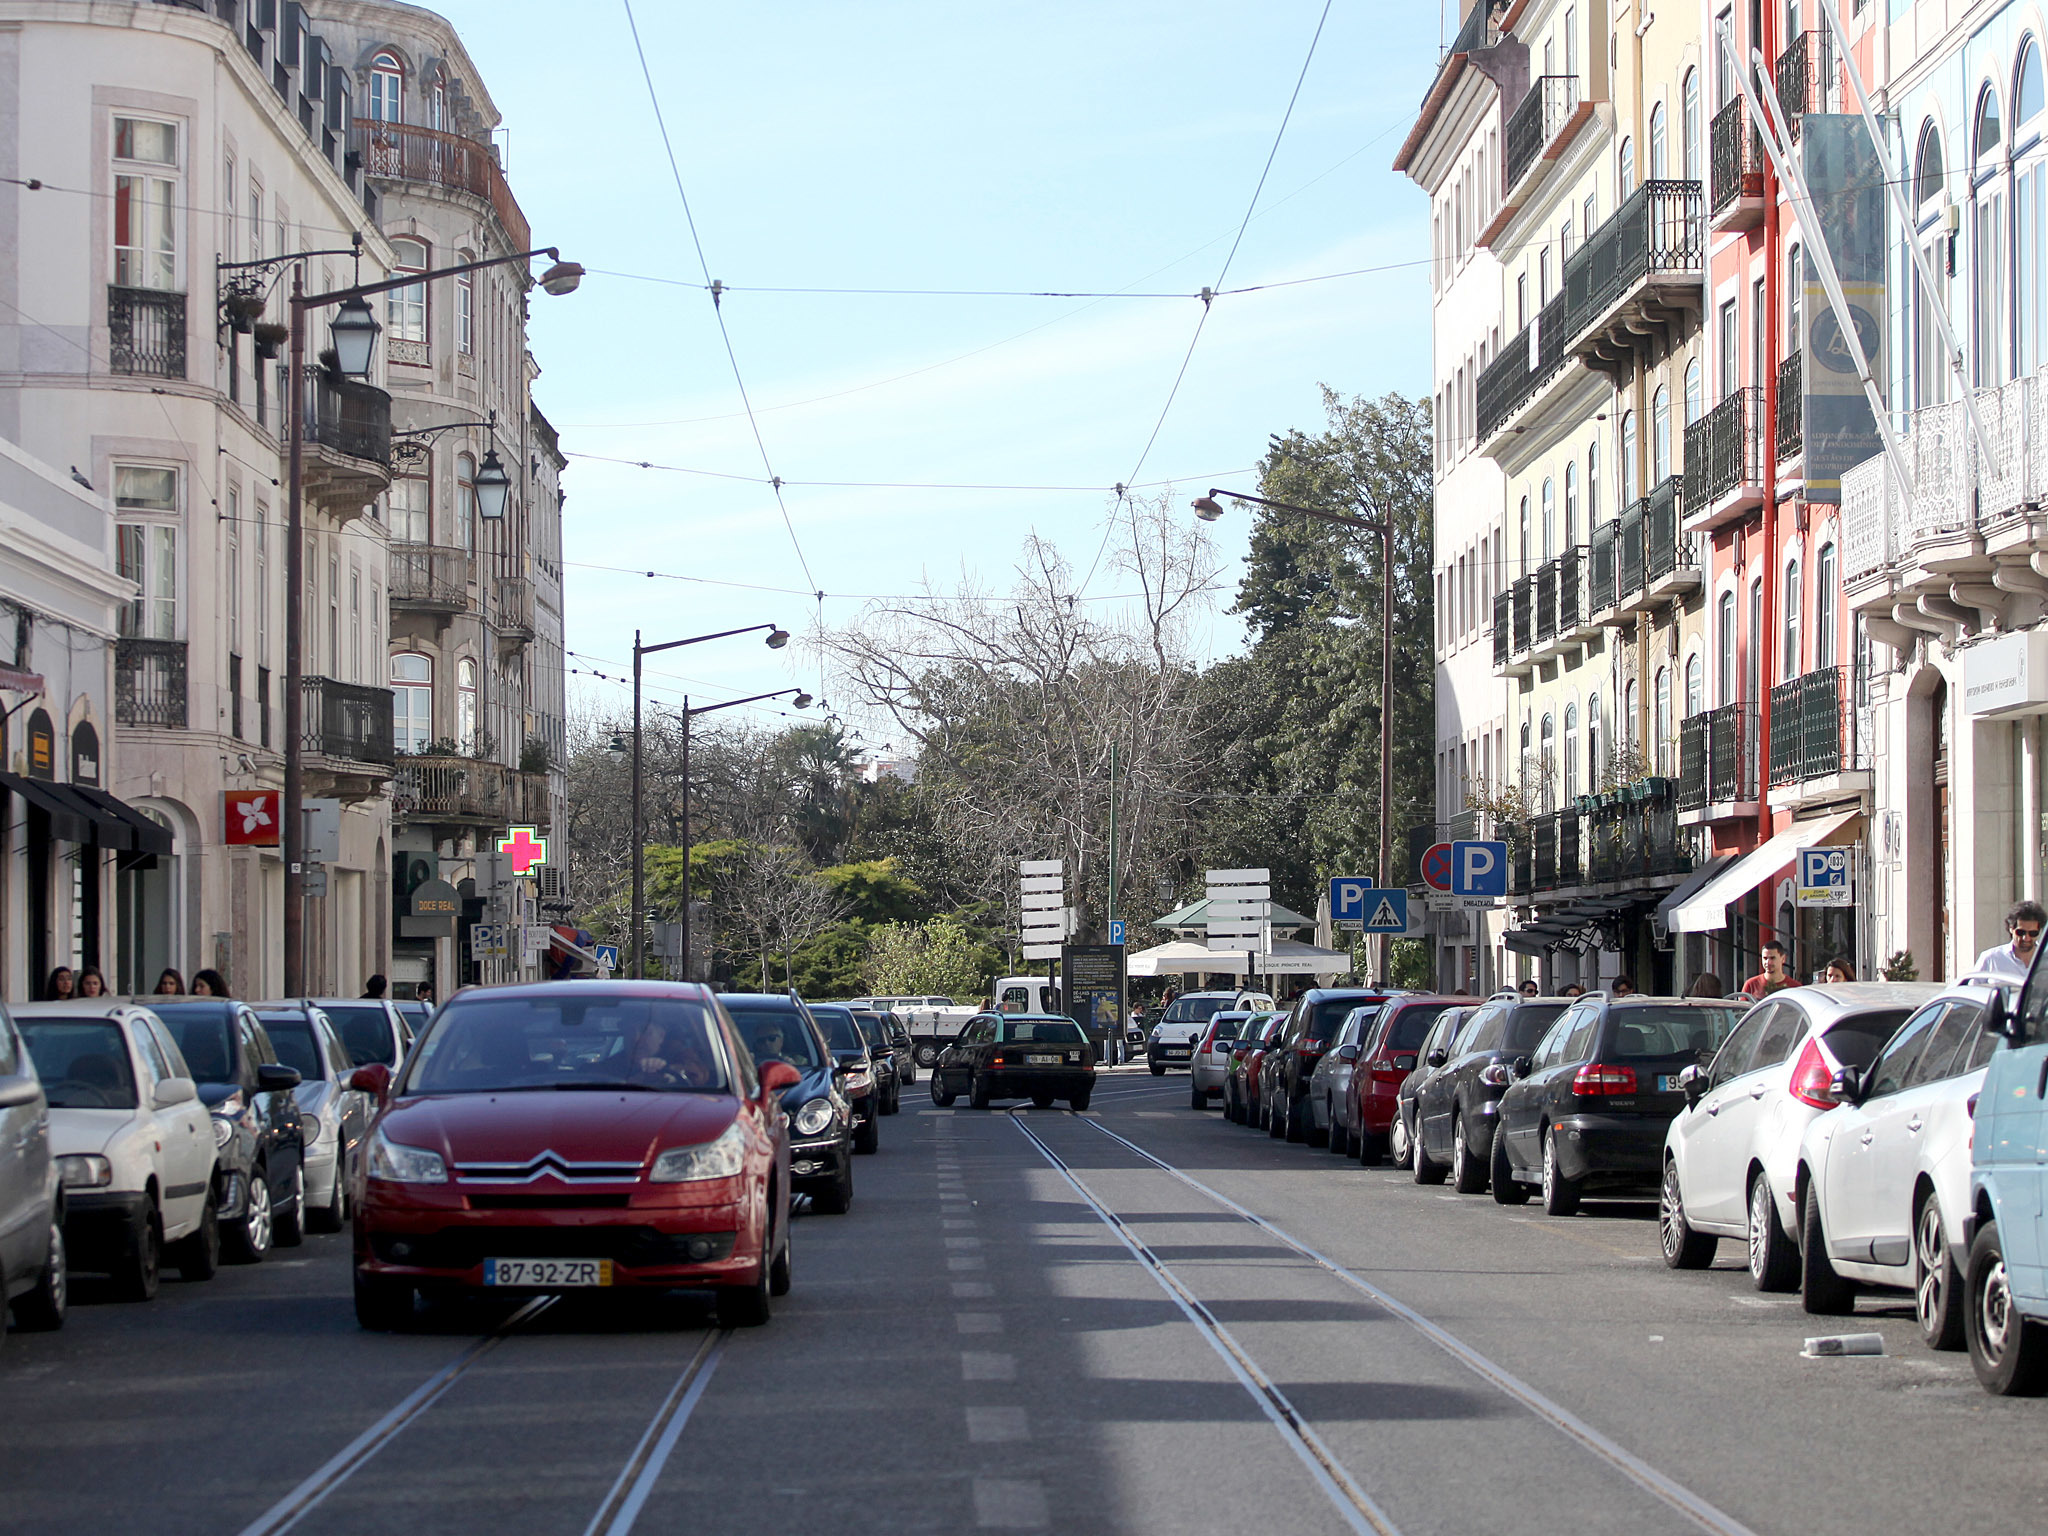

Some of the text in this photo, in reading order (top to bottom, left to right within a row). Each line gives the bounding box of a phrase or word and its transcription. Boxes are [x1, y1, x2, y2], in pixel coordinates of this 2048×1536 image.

[1463, 847, 1494, 890] P
[1807, 853, 1828, 887] P
[418, 901, 455, 910] DOCE REAL
[1341, 884, 1362, 912] P
[478, 927, 492, 947] P
[1113, 924, 1122, 943] P
[499, 1263, 596, 1283] 87-92-ZR
